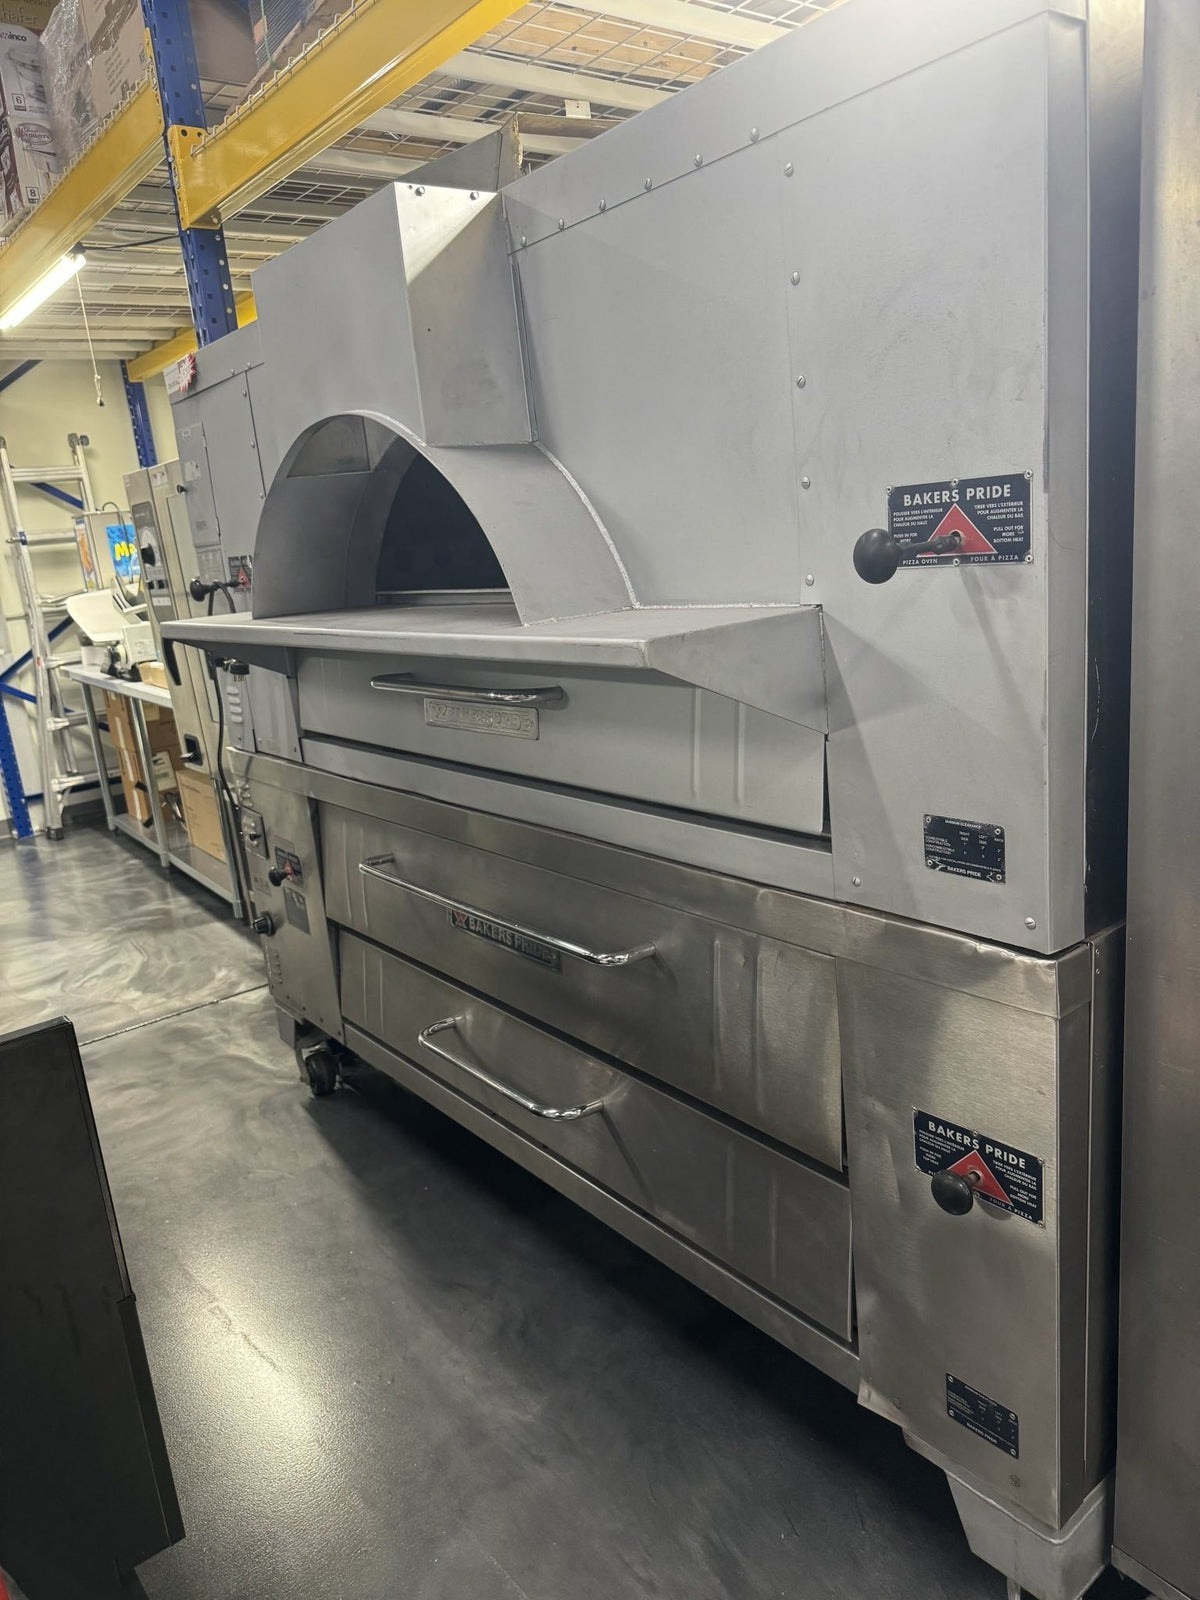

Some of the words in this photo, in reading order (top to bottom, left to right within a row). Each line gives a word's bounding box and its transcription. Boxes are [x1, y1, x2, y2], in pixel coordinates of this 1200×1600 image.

[904, 489, 959, 506] BAKERS
[966, 484, 1011, 500] PRIDE
[948, 866, 966, 874] BAKERS
[468, 917, 514, 946] BAKERS
[928, 1120, 980, 1149] BAKERS
[986, 1144, 1026, 1169] PRIDE
[1014, 1209, 1032, 1220] PIZZA
